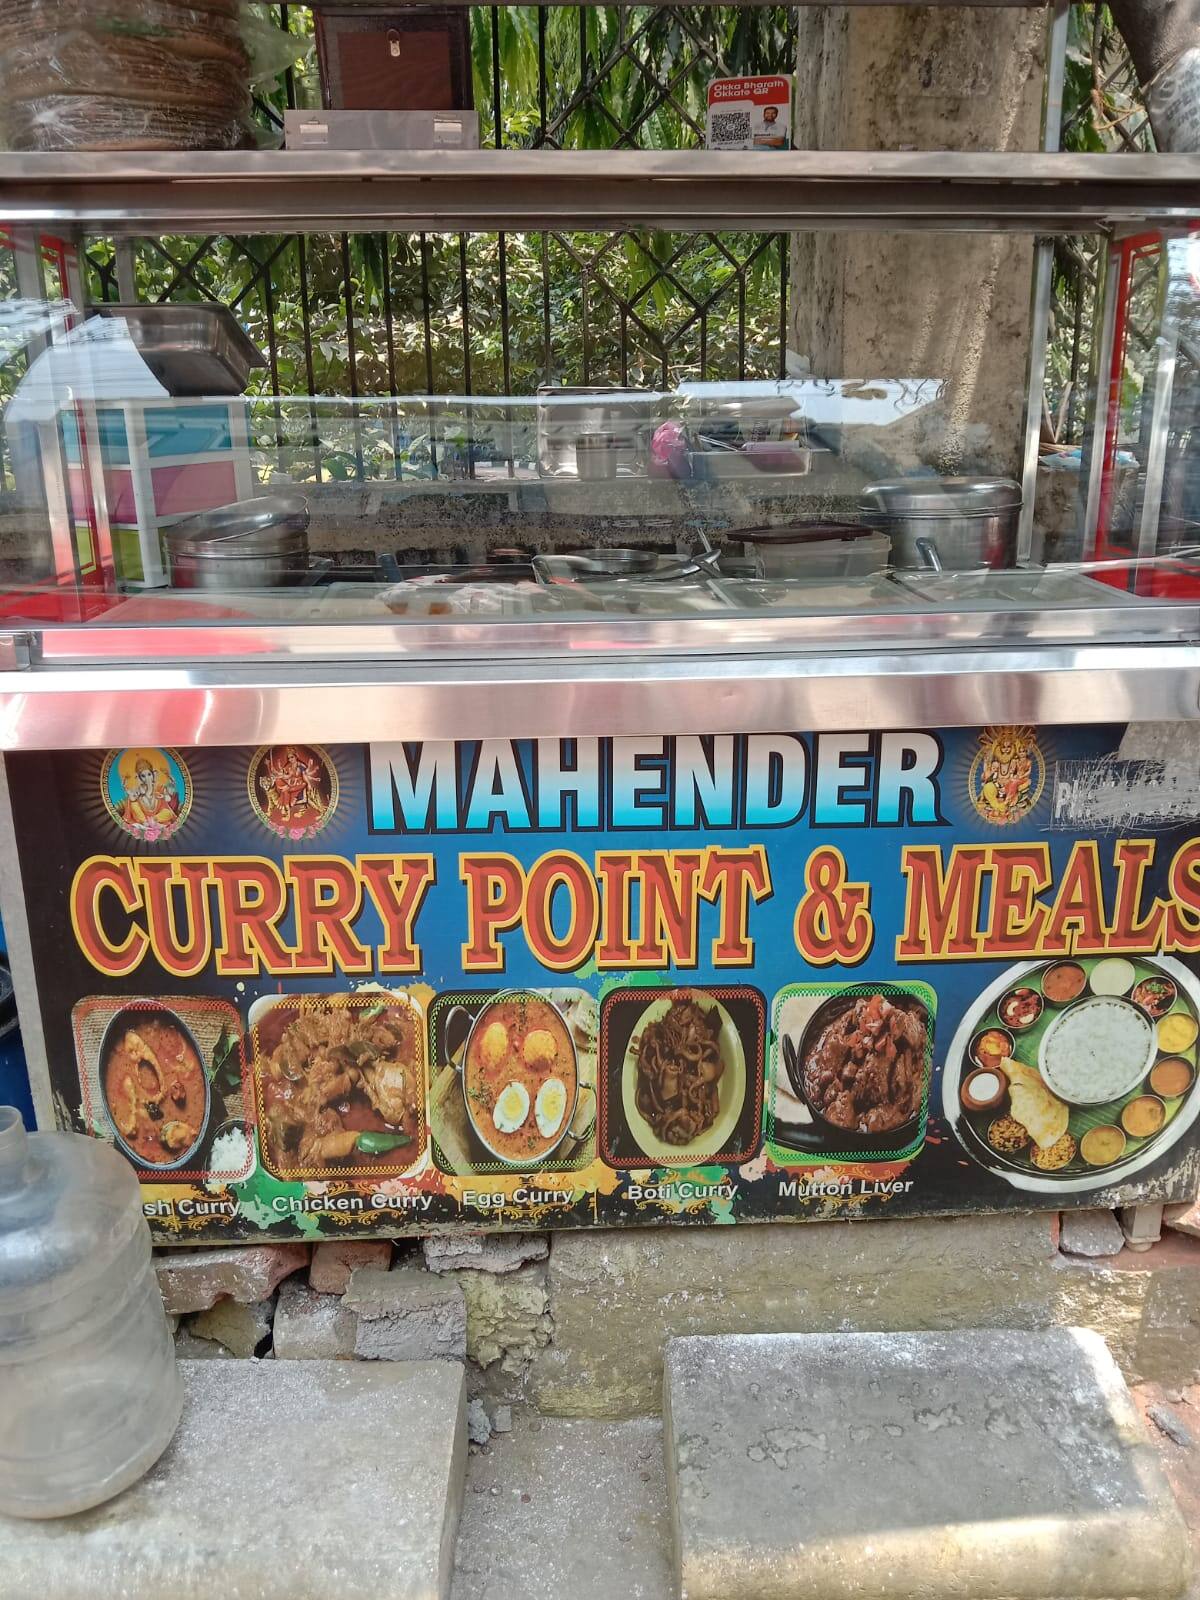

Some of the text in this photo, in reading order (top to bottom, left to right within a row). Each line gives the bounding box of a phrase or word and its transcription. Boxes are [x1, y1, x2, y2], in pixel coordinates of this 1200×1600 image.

[743, 80, 784, 89] Bharath
[753, 87, 769, 95] QR
[366, 732, 951, 834] MAHENDER
[70, 836, 1200, 977] CURRY POINT & MEALS
[462, 1187, 574, 1208] Egg Curry
[627, 1182, 739, 1200] Boti Curry
[778, 1179, 914, 1197] Mutton Liver
[142, 1198, 240, 1217] sh Curry
[271, 1193, 433, 1213] Chicken Curry
